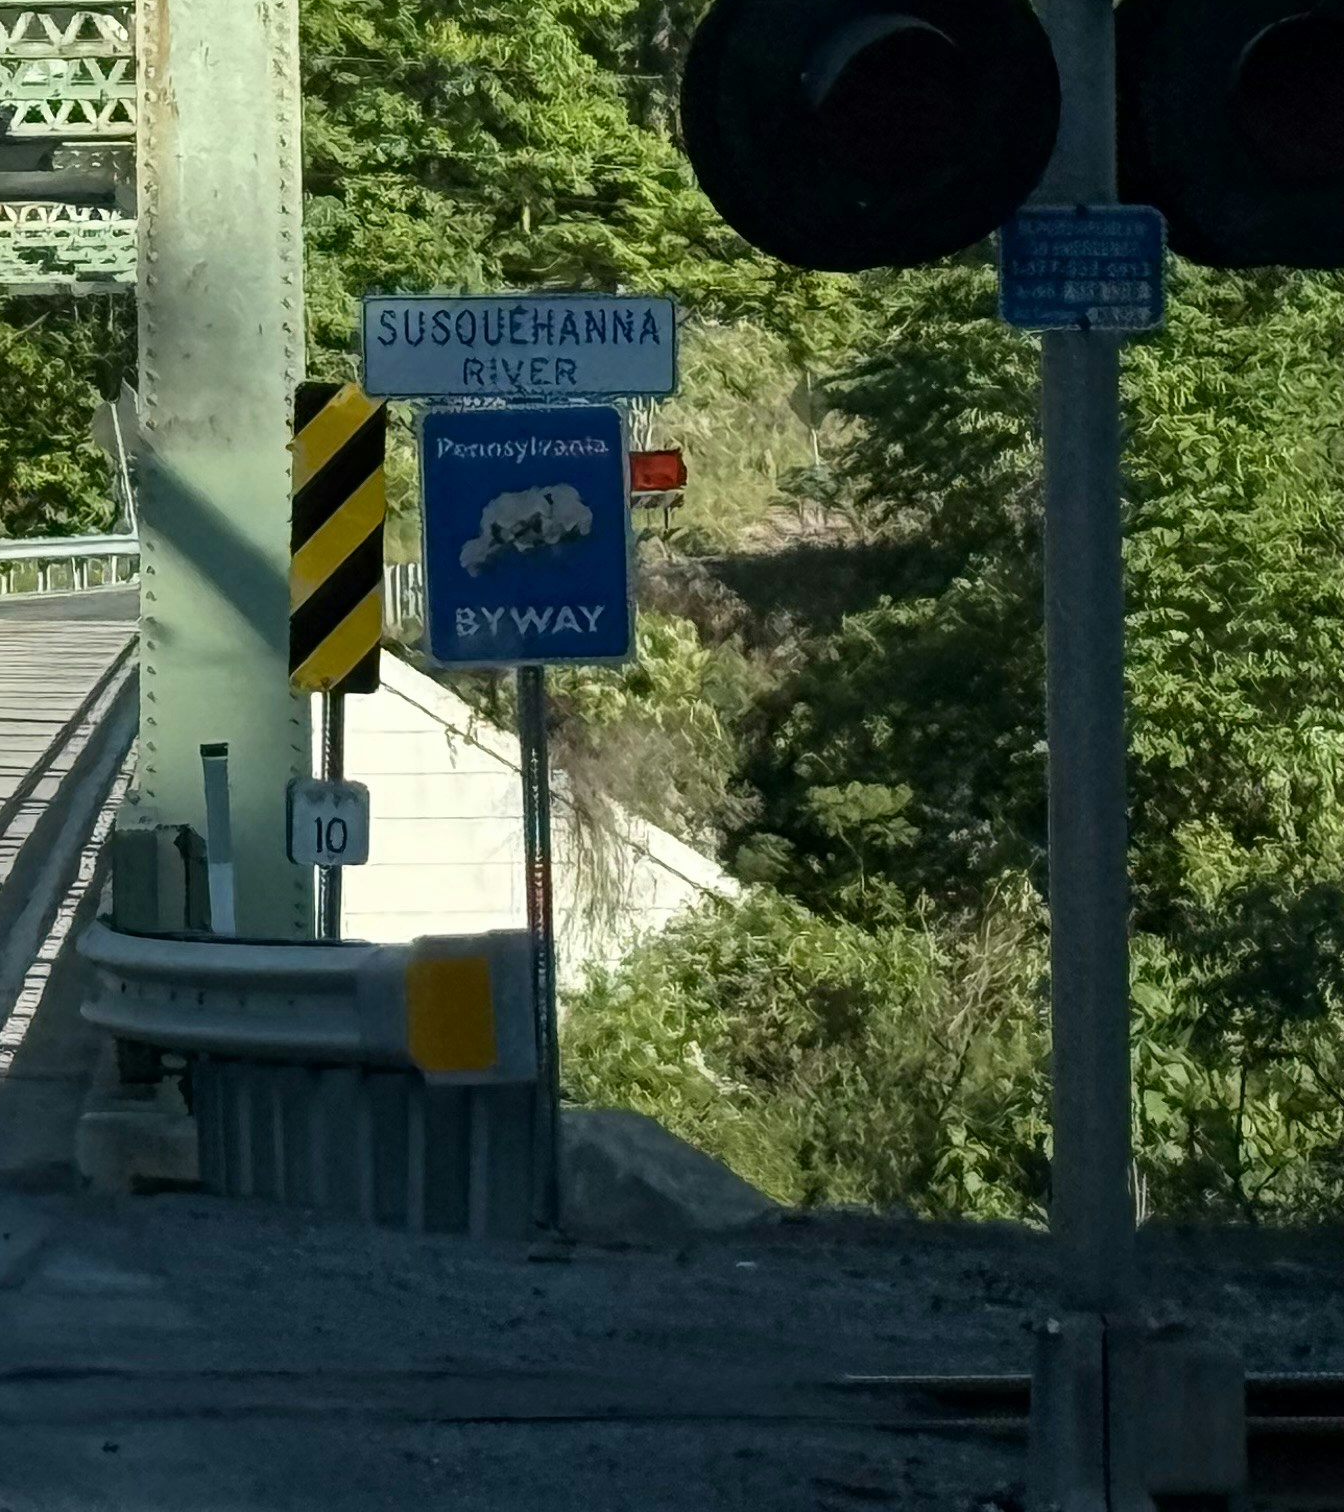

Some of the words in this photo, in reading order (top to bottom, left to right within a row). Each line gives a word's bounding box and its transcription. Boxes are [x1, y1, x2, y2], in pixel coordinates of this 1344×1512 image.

[377, 305, 661, 347] SUSQUEHANNA
[463, 357, 578, 387] RIVER
[436, 435, 610, 465] Pennsylvania
[455, 604, 607, 638] BYWAY
[313, 816, 349, 854] 10
